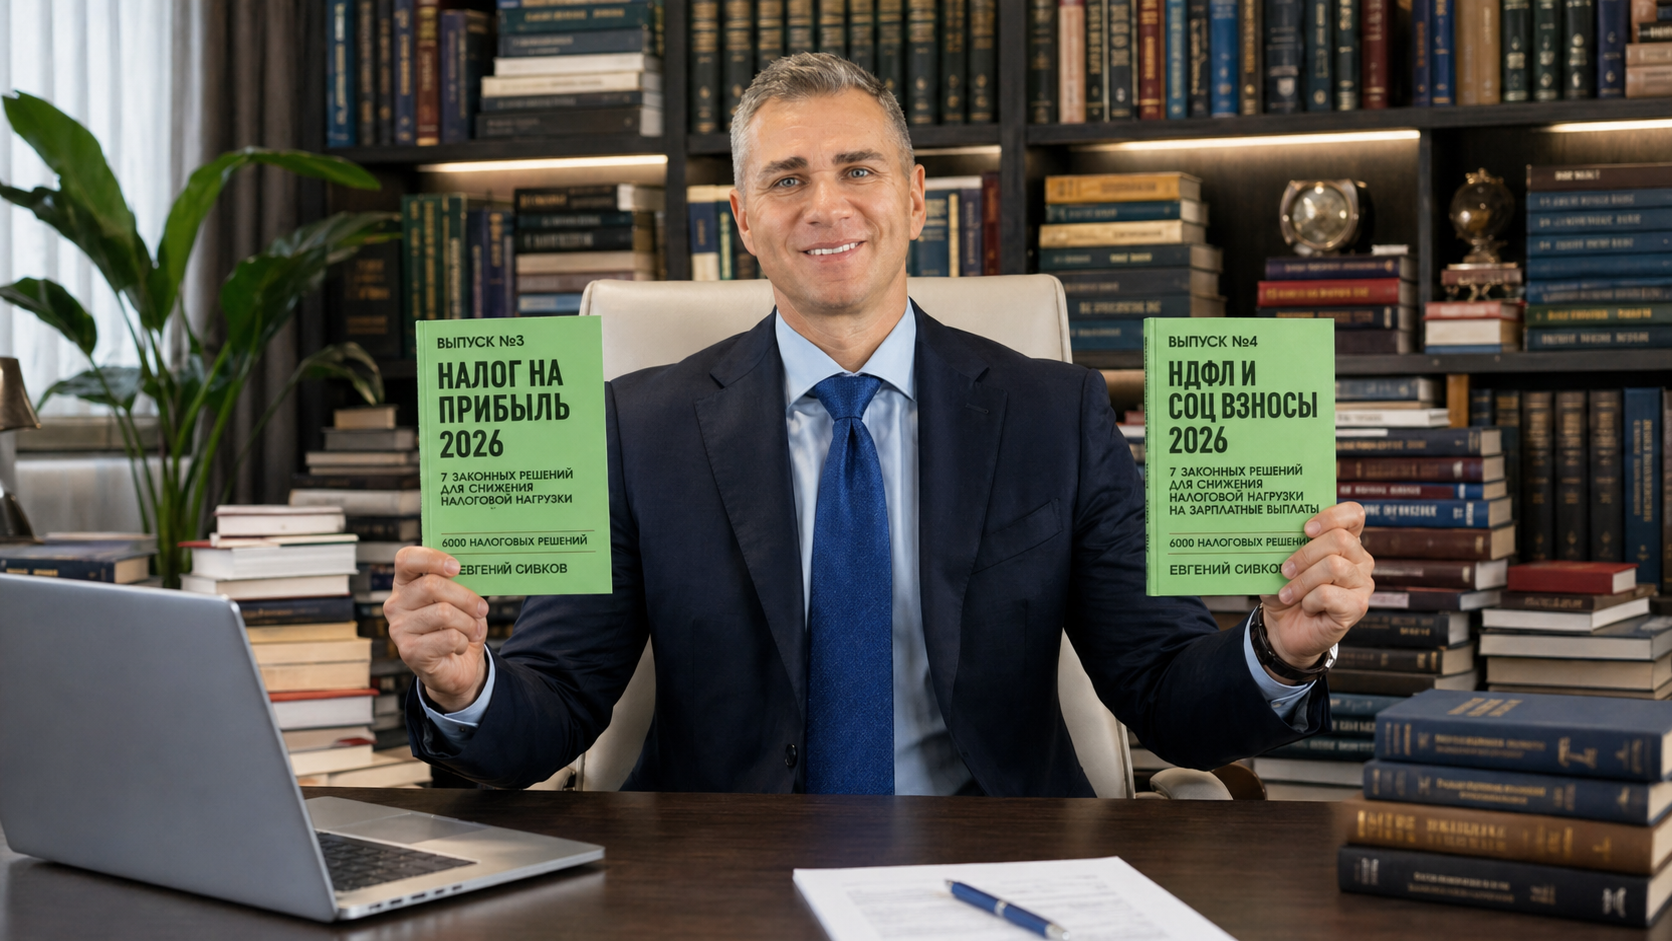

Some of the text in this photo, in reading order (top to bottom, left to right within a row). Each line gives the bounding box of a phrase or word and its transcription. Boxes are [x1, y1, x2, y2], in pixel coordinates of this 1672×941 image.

[437, 335, 525, 349] ВЫПУСК №3
[1168, 336, 1258, 348] ВЫПУСК №4
[437, 359, 564, 390] НАЛОГ НА
[1168, 360, 1256, 390] НДФЛ И
[438, 393, 570, 424] ПРИБЫЛЬ
[1168, 392, 1318, 423] СОЦ ВЗНОСЫ
[439, 430, 504, 459] 2026
[1168, 426, 1228, 454] 2026
[440, 468, 573, 482] 7 ЗАКОННЫХ РЕШЕНИЙ
[1169, 464, 1303, 477] 7 ЗАКОННЫХ РЕШЕНИЙ
[440, 483, 534, 495] ДЛЯ СНИЖЕНИЯ
[1169, 479, 1263, 491] ДЛЯ СНИЖЕНИЯ
[440, 494, 573, 506] НАЛОГОВОЙ НАГРУЗКИ
[1169, 490, 1304, 503] НАЛОГОВОЙ НАГРУЗКИ
[1169, 505, 1320, 515] НА ЗАРПЛАТНЫЕ ВЫПЛАТЫ
[441, 534, 588, 548] 6000 НАЛОГОВЫХ РЕШЕНИЙ
[1169, 539, 1195, 548] 6000
[1197, 538, 1263, 548] НАЛОГОВЫХ
[459, 562, 568, 576] ЕВГЕНИЙ СИВКОВ
[1169, 562, 1283, 576] ЕВГЕНИЙ СИВКО
